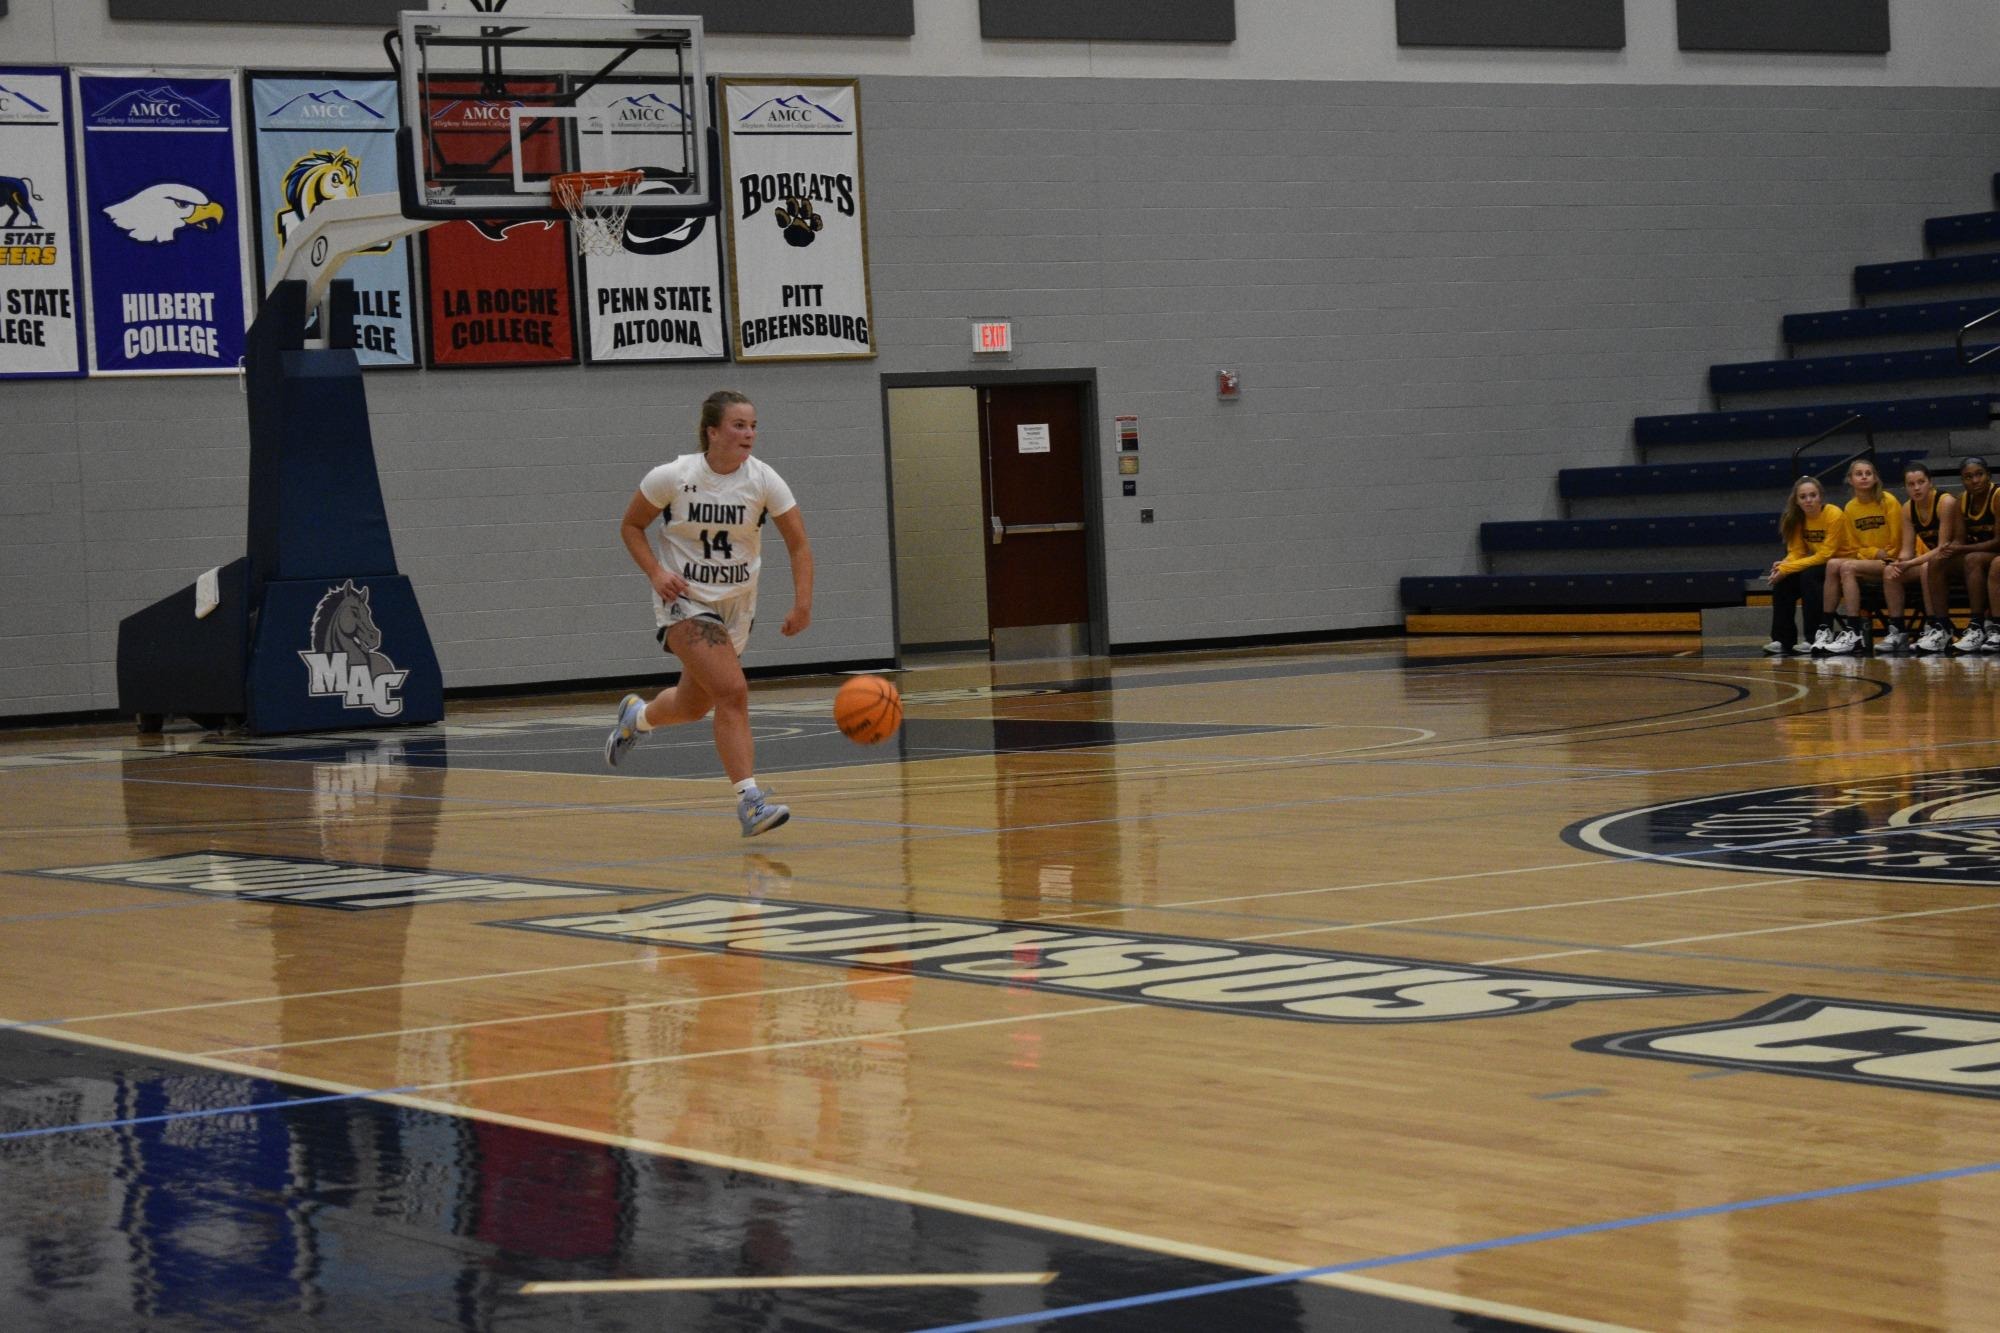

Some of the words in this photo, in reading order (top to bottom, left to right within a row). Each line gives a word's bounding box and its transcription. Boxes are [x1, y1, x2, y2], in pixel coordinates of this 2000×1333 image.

[129, 103, 181, 117] AMCC
[301, 104, 349, 118] AMCC
[463, 106, 511, 120] AMCC
[619, 108, 665, 121] AMCC
[768, 109, 812, 122] AMCC
[740, 172, 855, 221] BOBCATS
[4, 232, 55, 246] STATE
[7, 288, 72, 319] STATE
[122, 292, 215, 324] HILBERT
[353, 290, 402, 319] ILLE
[443, 289, 472, 318] LA
[477, 288, 559, 317] ROCHE
[597, 287, 649, 316] PENN
[653, 286, 712, 314] STATE
[782, 284, 823, 308] PITT
[123, 324, 220, 360] COLLEGE
[452, 318, 554, 350] COLLEGE
[613, 318, 703, 349] ALTOONA
[741, 313, 869, 349] GREENSBURG
[981, 325, 1006, 348] EXIT
[687, 502, 746, 525] MOUNT
[700, 529, 733, 559] 14
[683, 562, 750, 584] ALOYSIUS
[299, 651, 408, 716] MAC
[525, 899, 1663, 1018] ALOYSIUS
